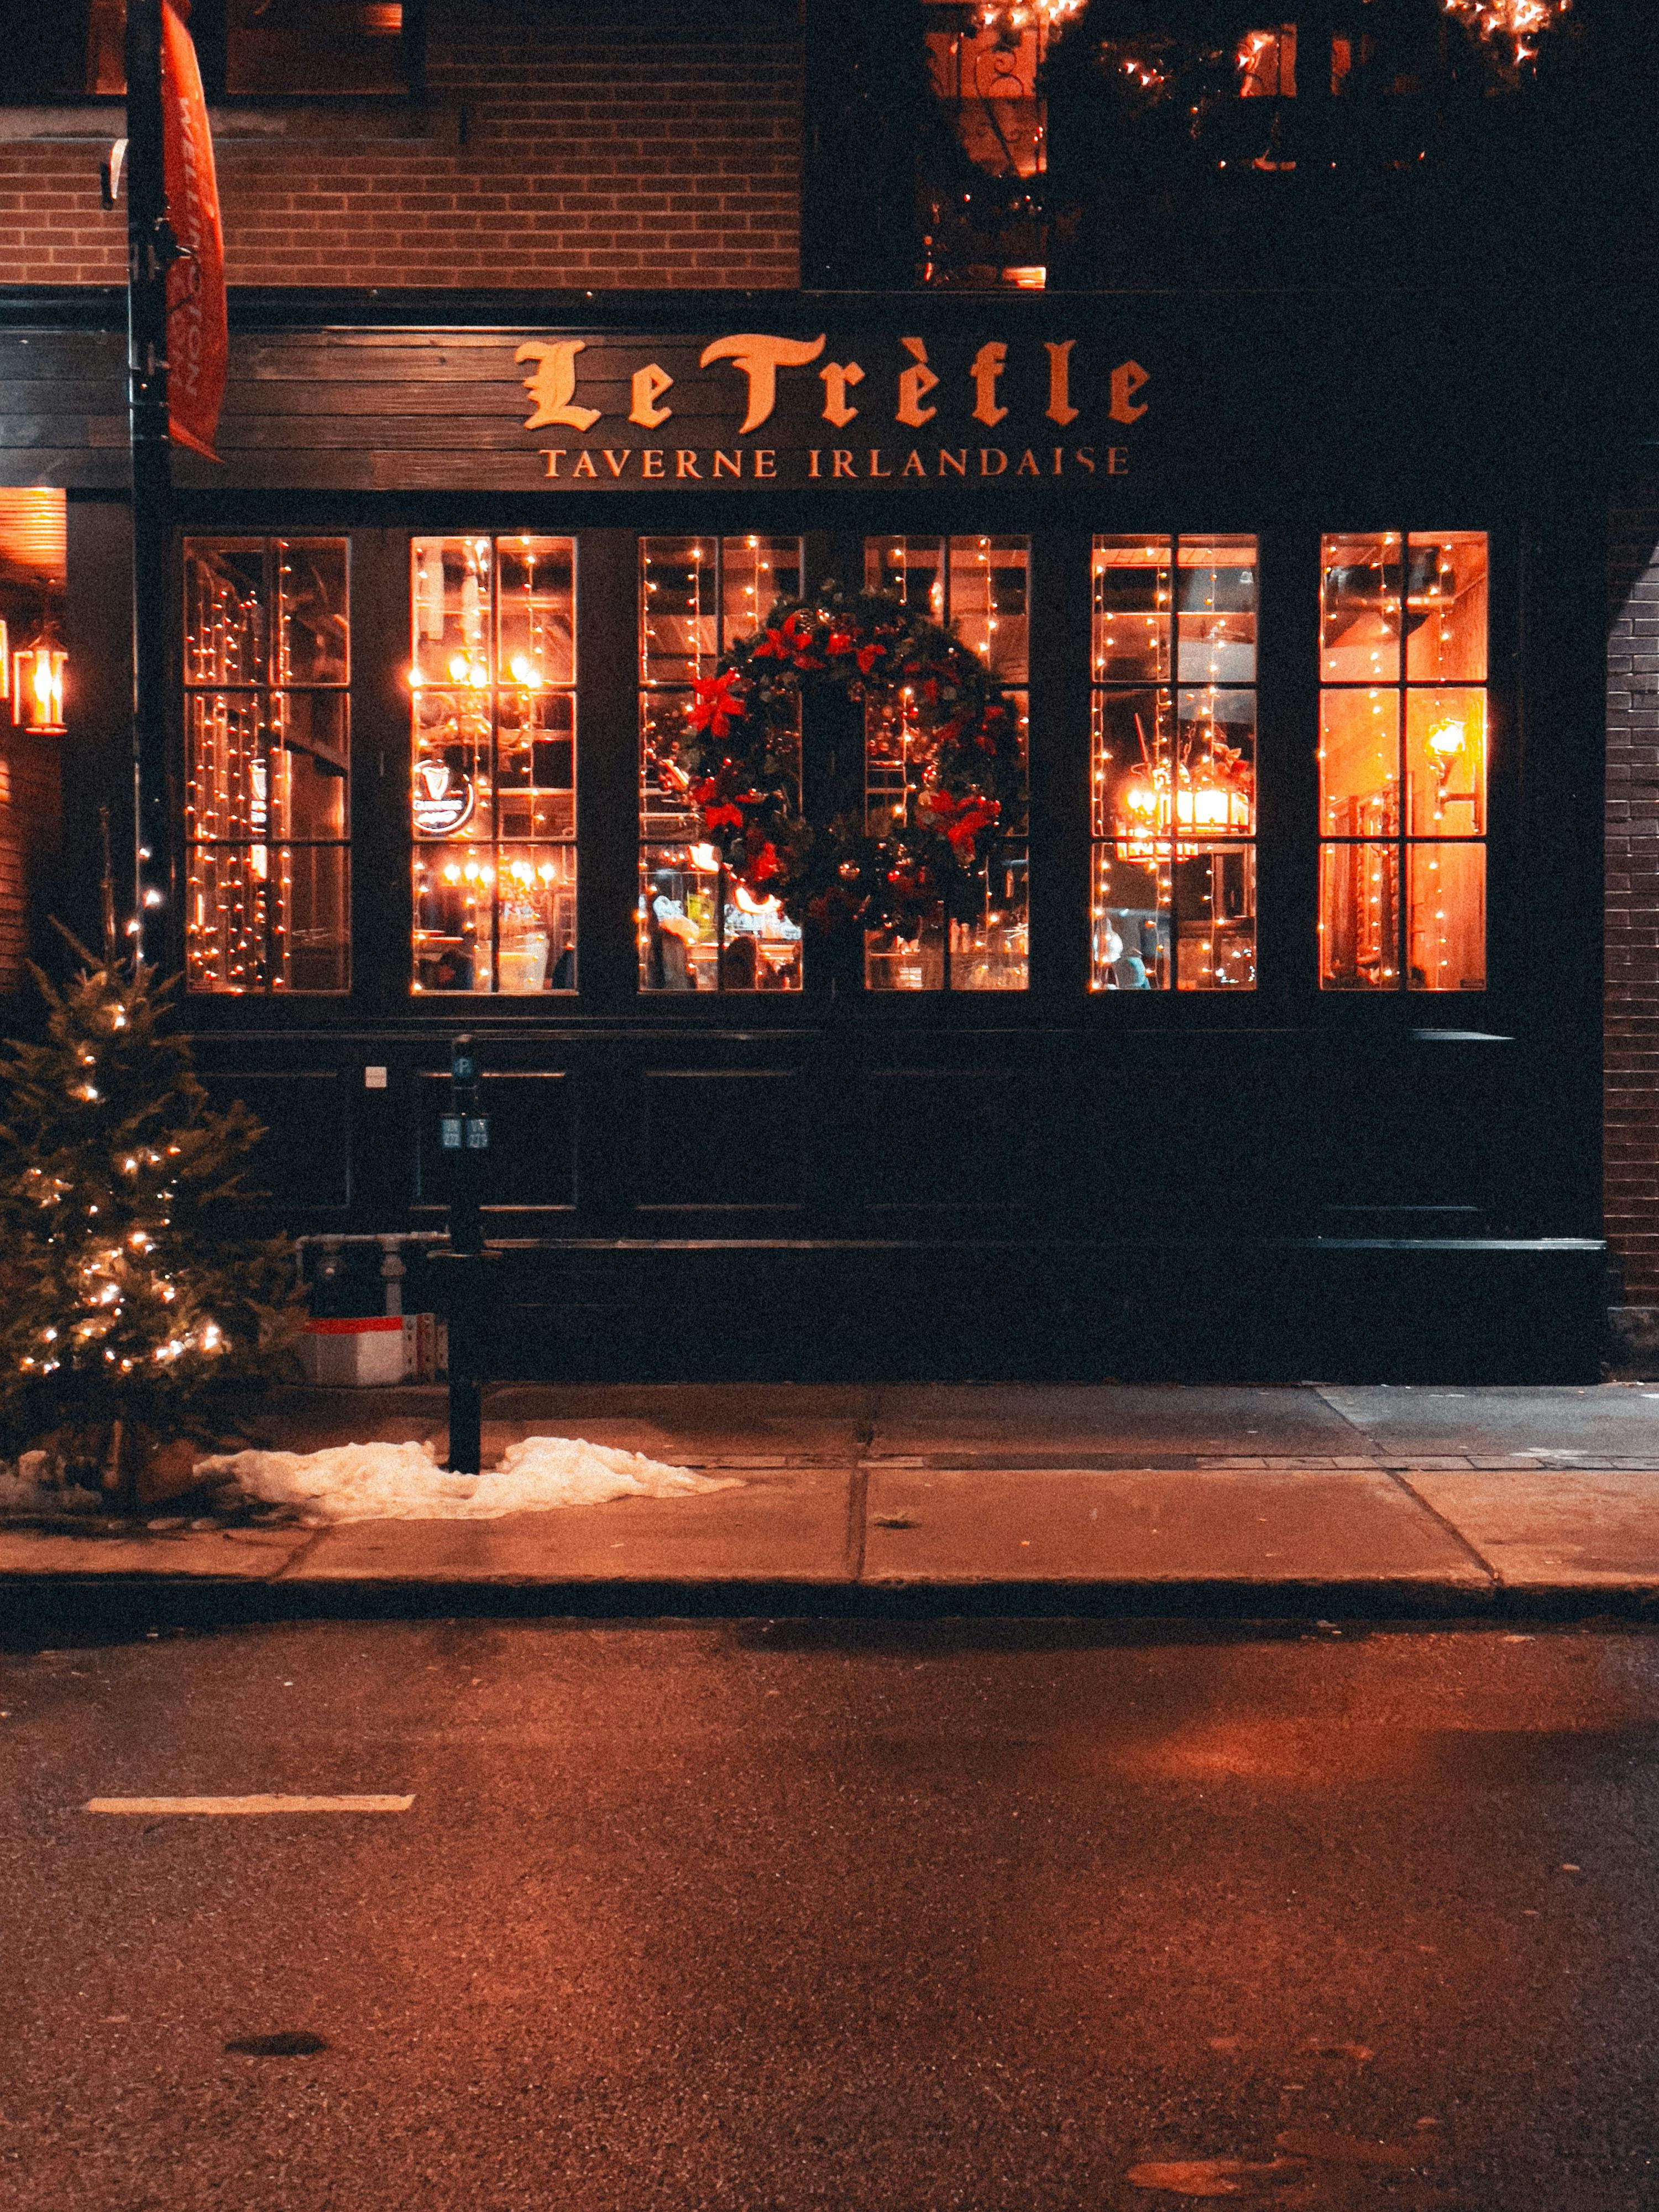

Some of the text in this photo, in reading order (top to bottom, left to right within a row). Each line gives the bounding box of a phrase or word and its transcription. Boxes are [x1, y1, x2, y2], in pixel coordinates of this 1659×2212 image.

[515, 333, 1150, 434] Le Trèfle
[540, 447, 1129, 479] TAVERNE IRLANDAISE
